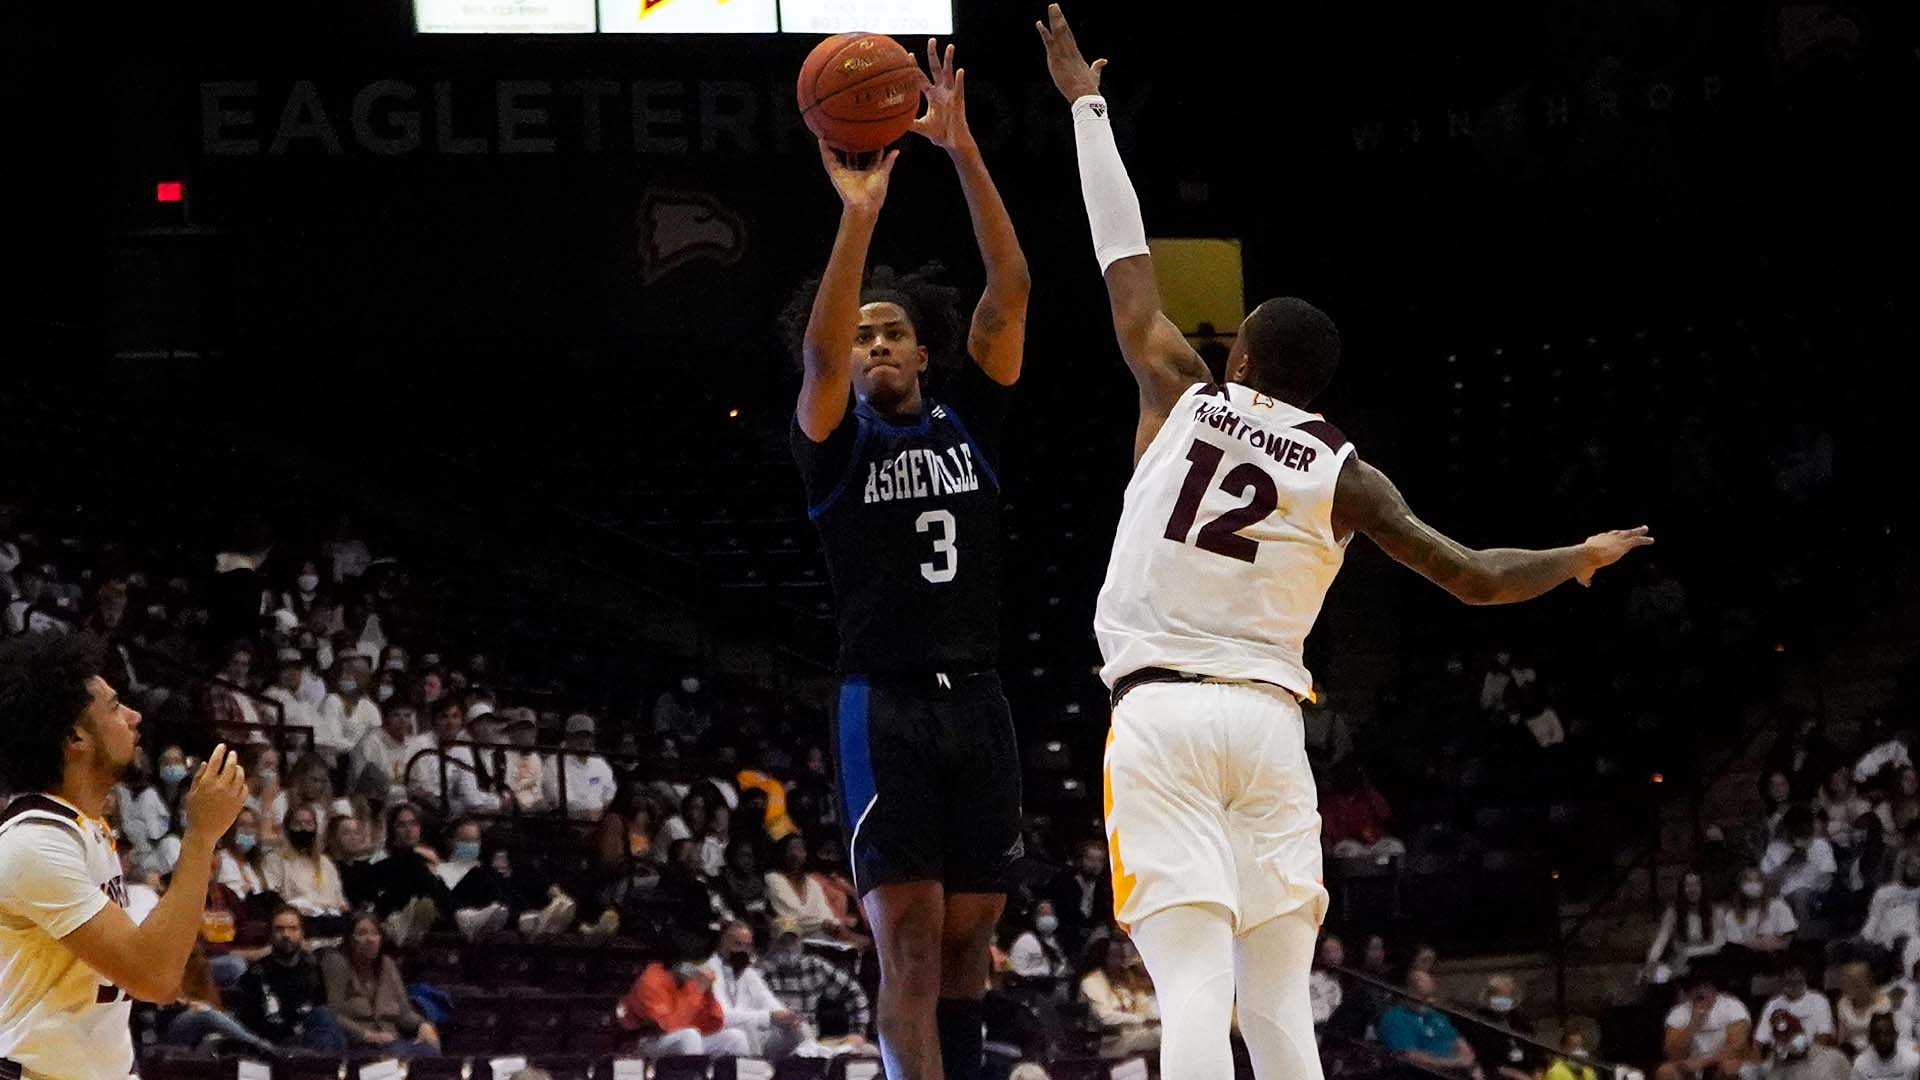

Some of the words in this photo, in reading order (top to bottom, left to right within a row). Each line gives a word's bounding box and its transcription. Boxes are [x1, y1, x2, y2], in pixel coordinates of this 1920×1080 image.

[864, 443, 979, 504] ASHEVILLE
[1163, 438, 1278, 564] 12
[915, 509, 957, 583] 3
